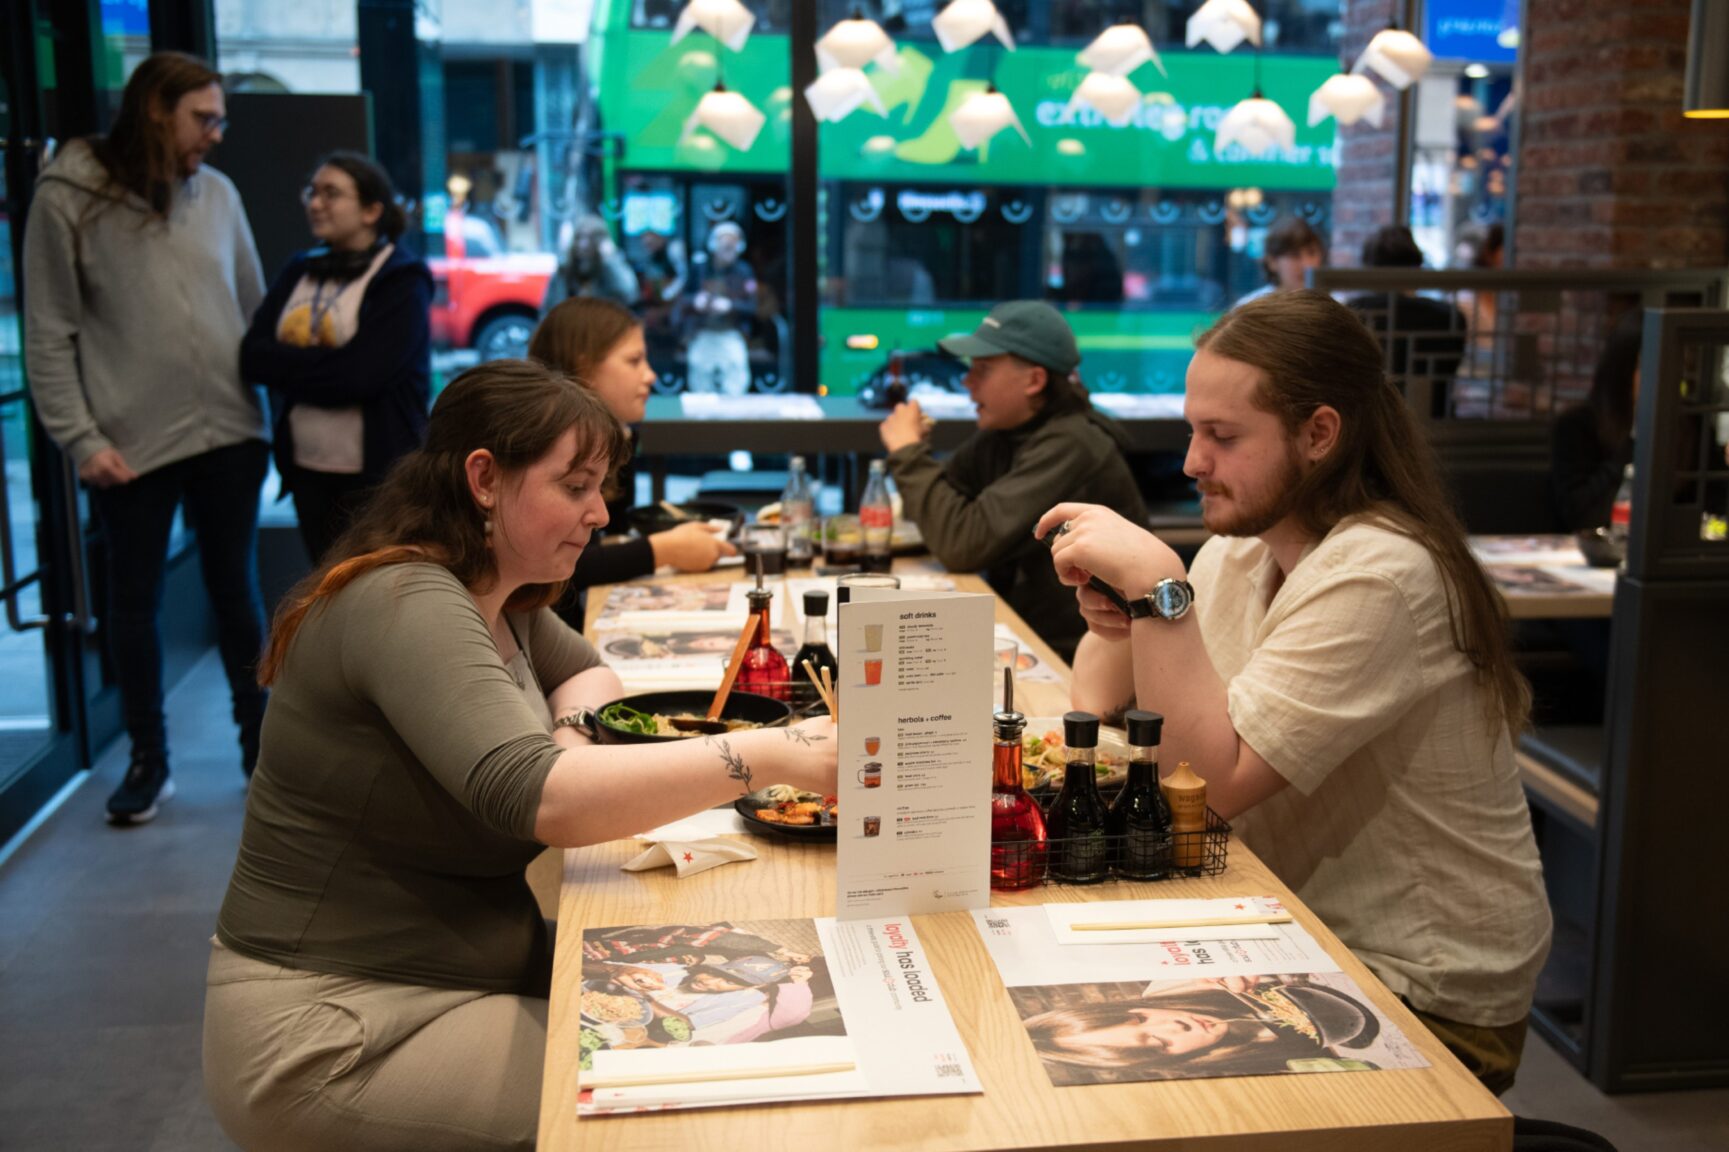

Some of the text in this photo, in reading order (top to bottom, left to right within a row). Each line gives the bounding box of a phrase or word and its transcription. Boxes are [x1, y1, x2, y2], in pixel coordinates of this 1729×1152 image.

[899, 611, 937, 620] soft drinks
[930, 713, 952, 722] coffee
[1192, 947, 1215, 964] has
[883, 923, 933, 1002] loyalty has loaded
